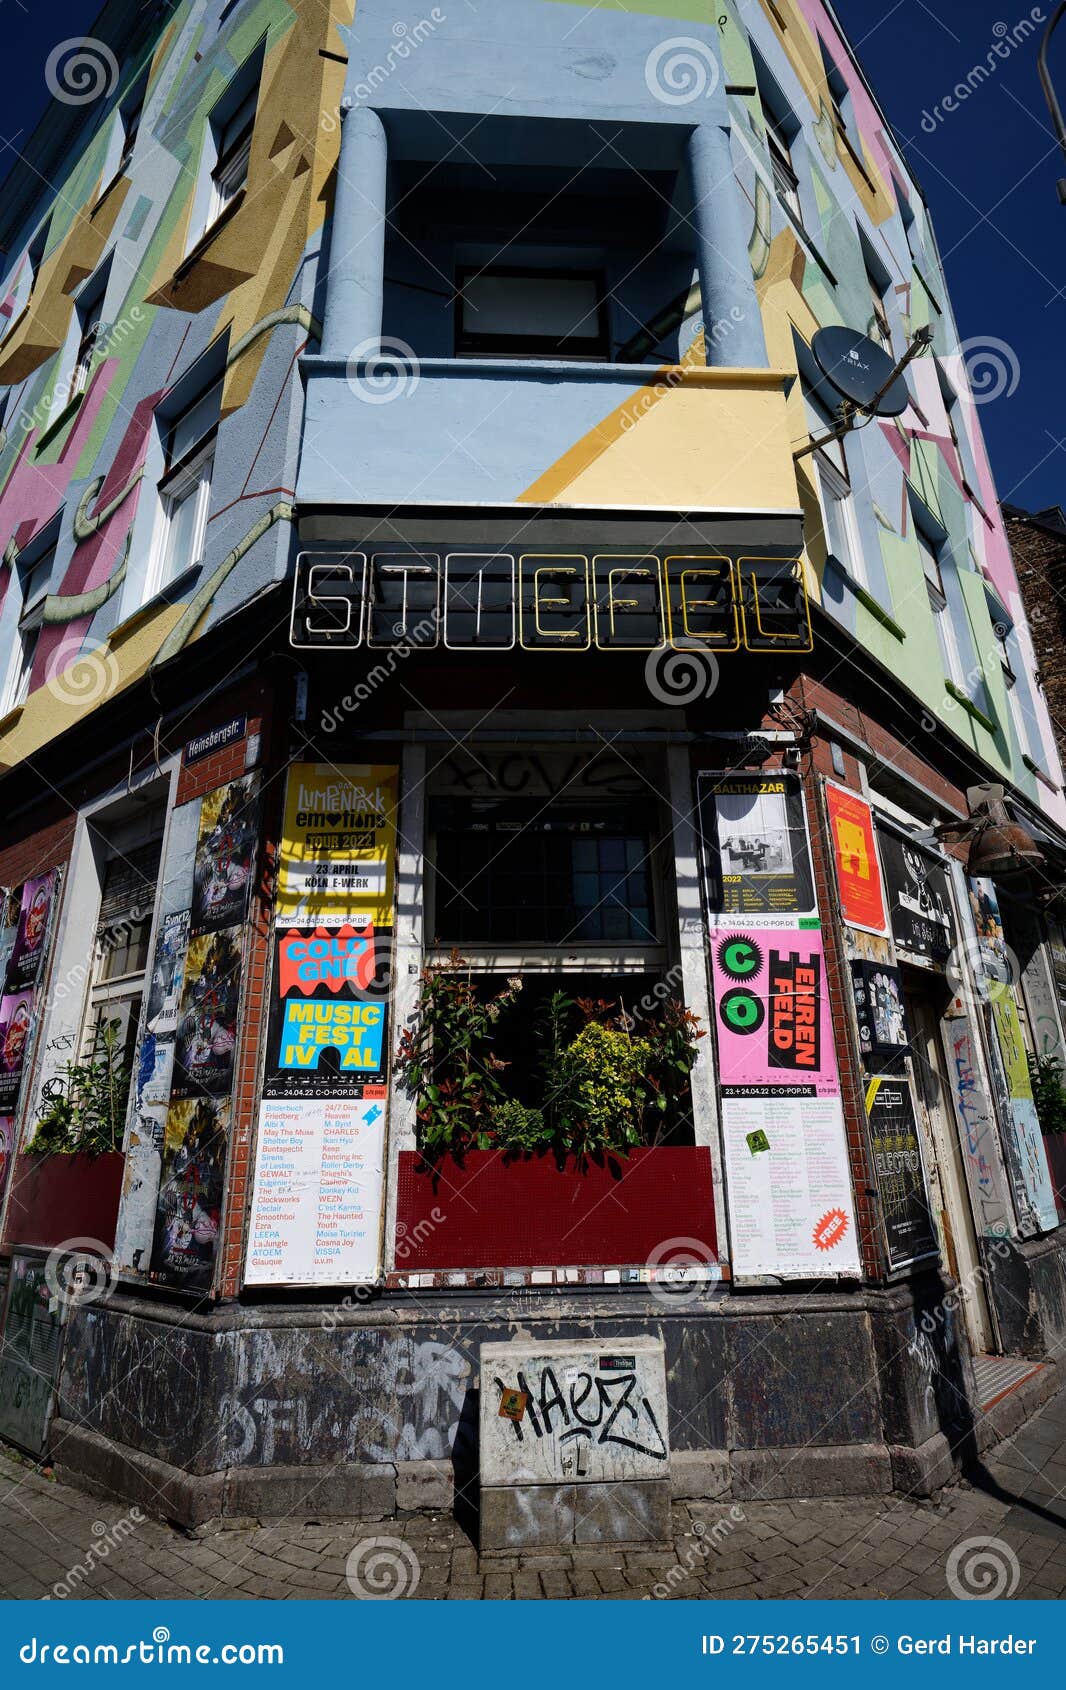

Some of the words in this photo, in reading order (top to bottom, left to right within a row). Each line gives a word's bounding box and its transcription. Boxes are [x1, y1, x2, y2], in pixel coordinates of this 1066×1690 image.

[838, 352, 870, 371] TRIAX
[304, 562, 803, 641] STIEFEL
[188, 720, 239, 757] Heinsbergstr.
[714, 784, 784, 793] BALTHAZAR
[308, 835, 339, 848] TOUR
[343, 835, 372, 848] 2022
[316, 865, 328, 874] 23
[333, 865, 359, 875] APRIL
[305, 875, 328, 888] KÖLN
[333, 878, 368, 888] E-WERK
[287, 937, 368, 961] COLO
[725, 943, 756, 973] C
[298, 958, 358, 982] GNE
[288, 1004, 381, 1025] MUSIC
[726, 995, 758, 1027] O
[298, 1024, 367, 1046] FEST
[285, 1045, 317, 1064] IV
[342, 1047, 378, 1067] AL
[262, 1146, 303, 1154] Buntspecht
[319, 1187, 345, 1195] Donkey
[819, 1216, 843, 1243] FREE
